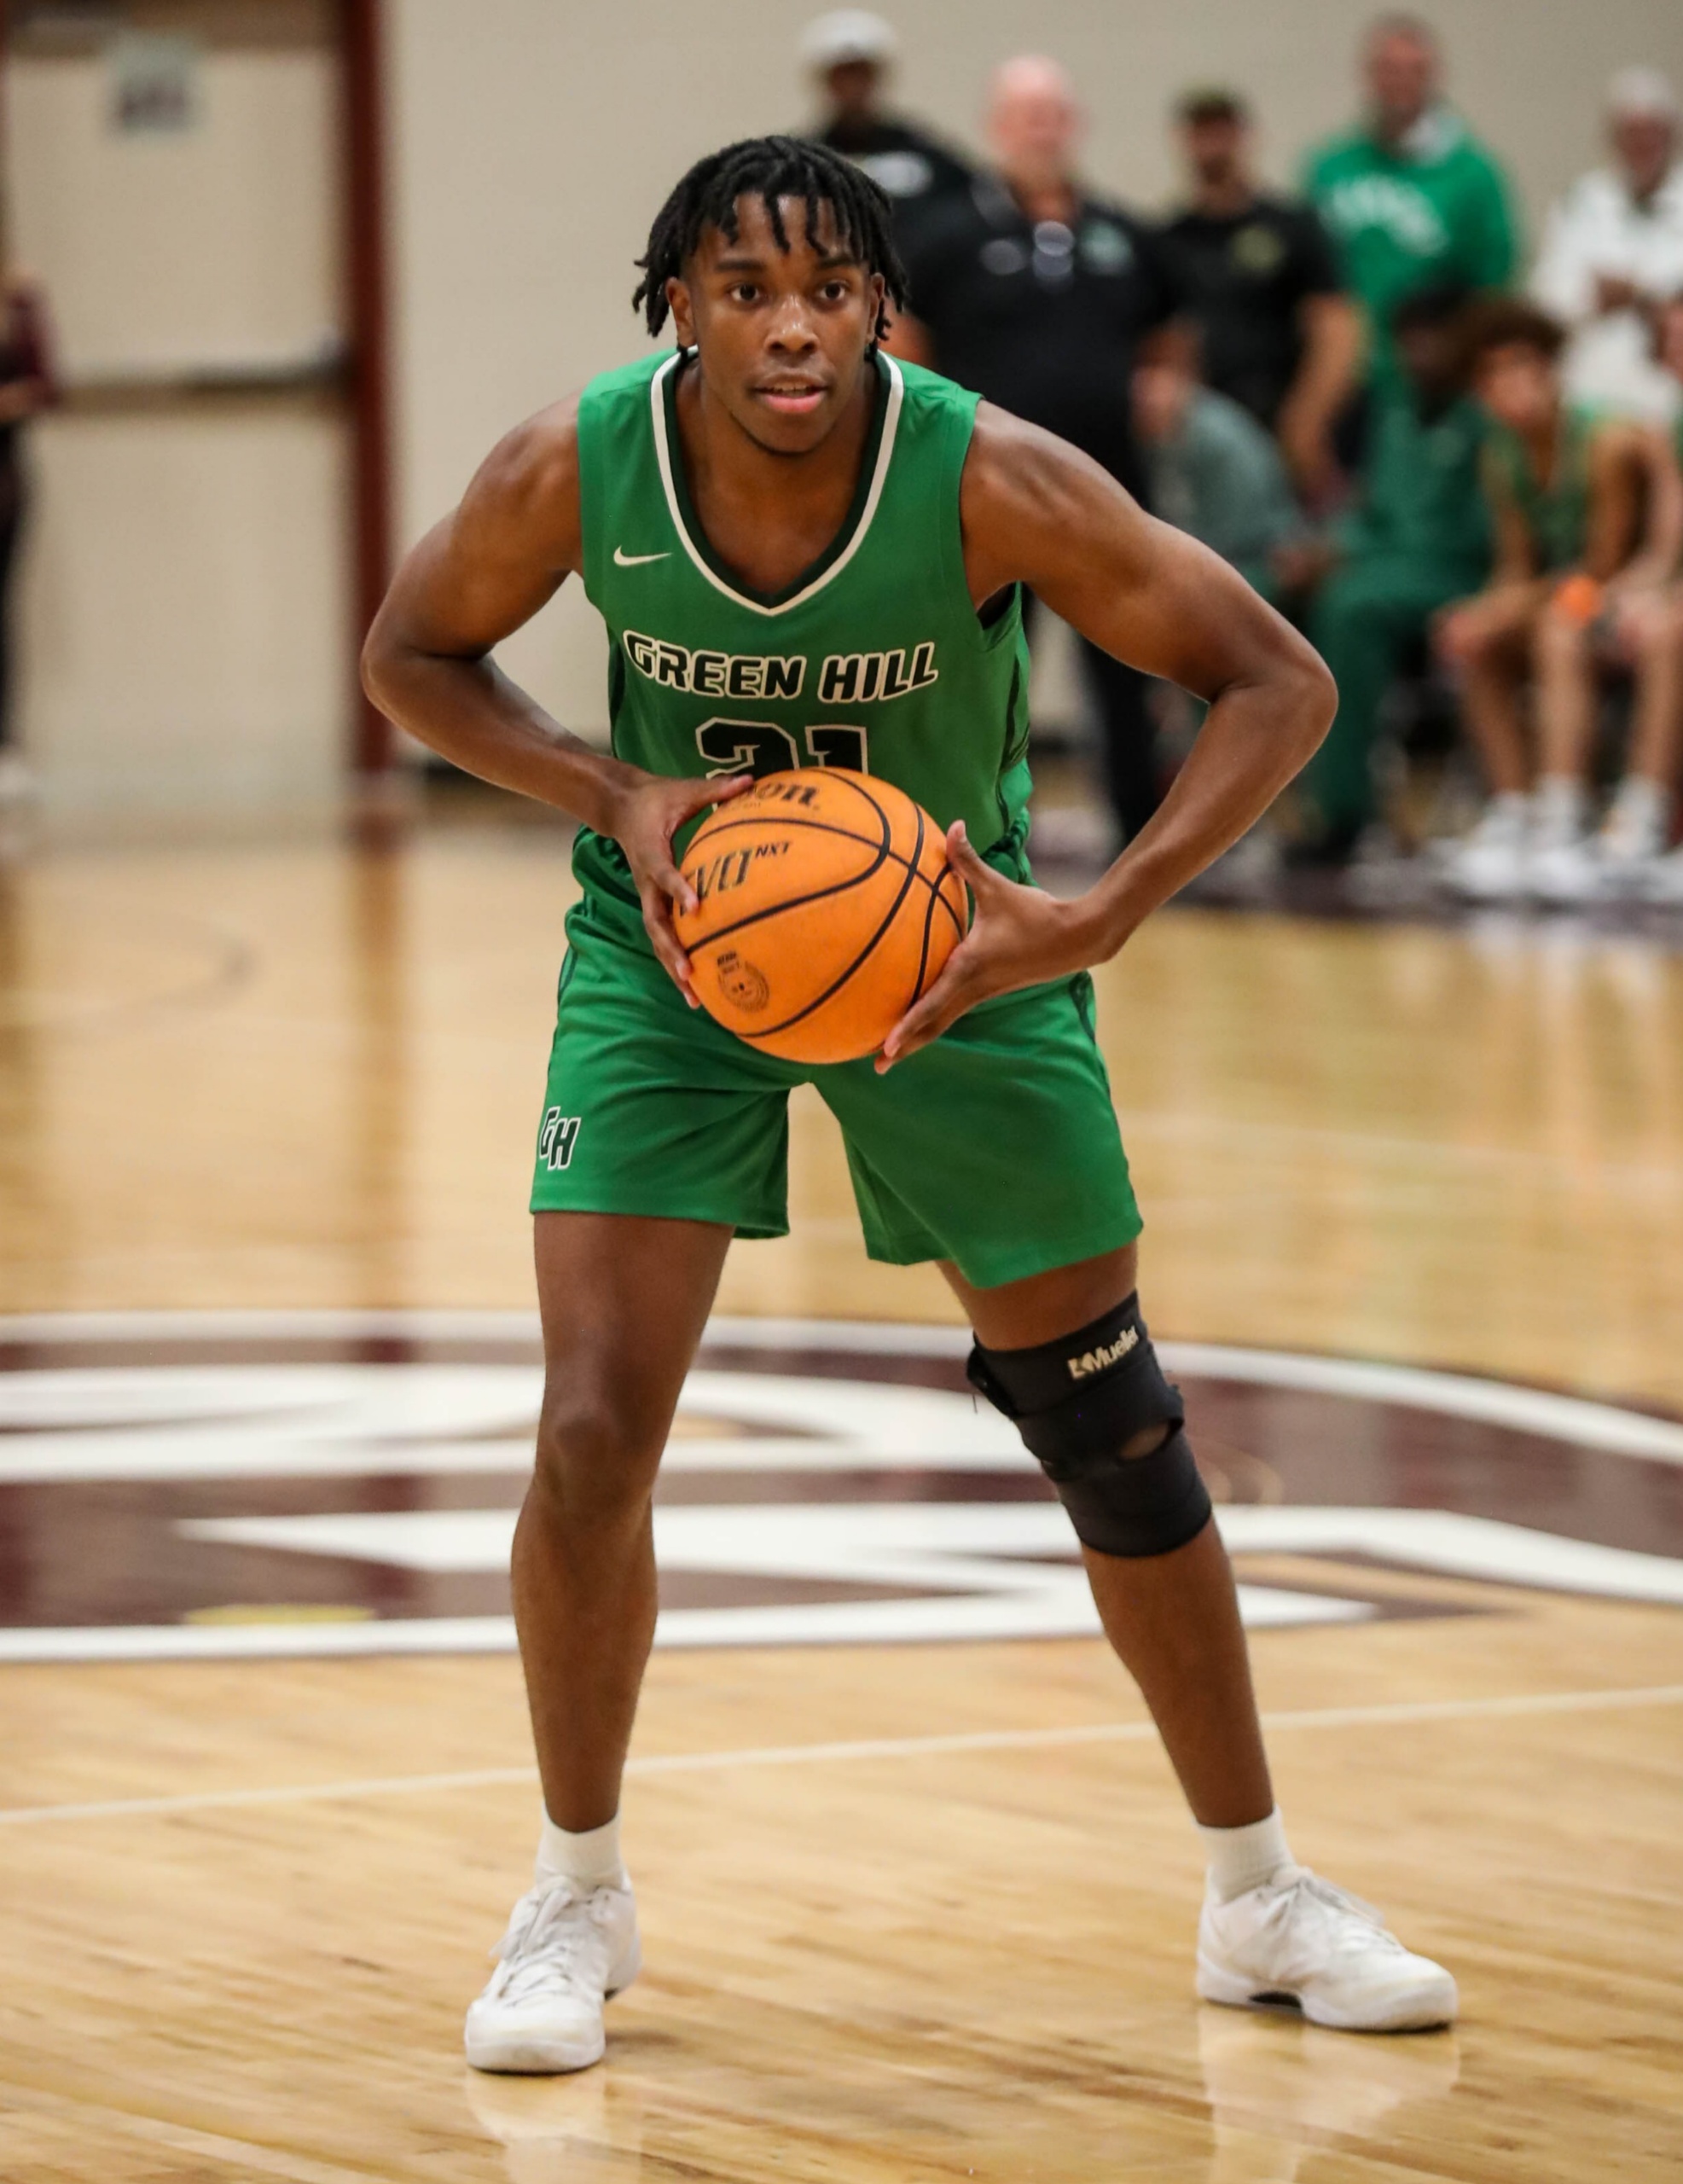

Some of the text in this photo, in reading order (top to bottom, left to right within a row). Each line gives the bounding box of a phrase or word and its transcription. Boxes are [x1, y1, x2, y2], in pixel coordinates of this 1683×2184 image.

[624, 630, 938, 704] GREEN HILL
[755, 841, 792, 858] NXT
[539, 1106, 581, 1170] GH
